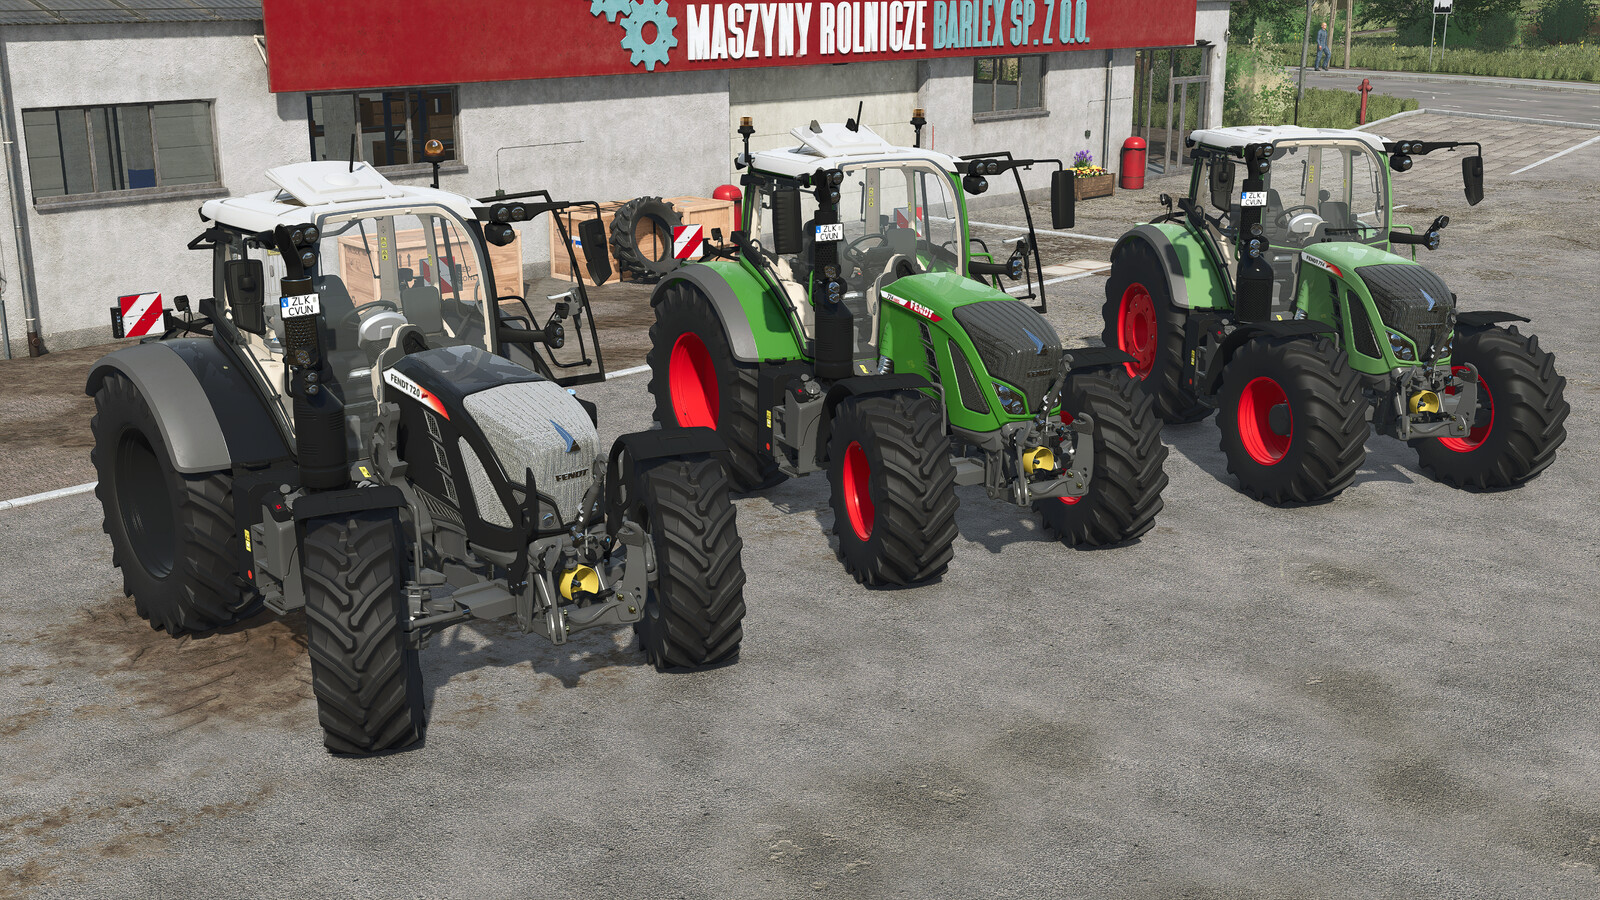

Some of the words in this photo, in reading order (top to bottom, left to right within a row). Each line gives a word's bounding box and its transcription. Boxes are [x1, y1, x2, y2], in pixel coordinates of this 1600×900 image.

[686, 2, 812, 60] MASZYNY
[819, 1, 928, 55] ROLNICZE
[933, 0, 1006, 50] BARLEX
[1010, 0, 1039, 46] SP.
[1042, 0, 1055, 45] Z
[1059, 0, 1090, 44] O.O.
[823, 225, 837, 233] ZLK
[820, 232, 838, 240] CVUN
[292, 295, 310, 306] ZLK
[288, 305, 313, 316] CVUN
[910, 299, 934, 318] FENDT
[390, 373, 409, 390] FENDT
[409, 384, 421, 397] 720
[555, 468, 588, 482] FENDT
